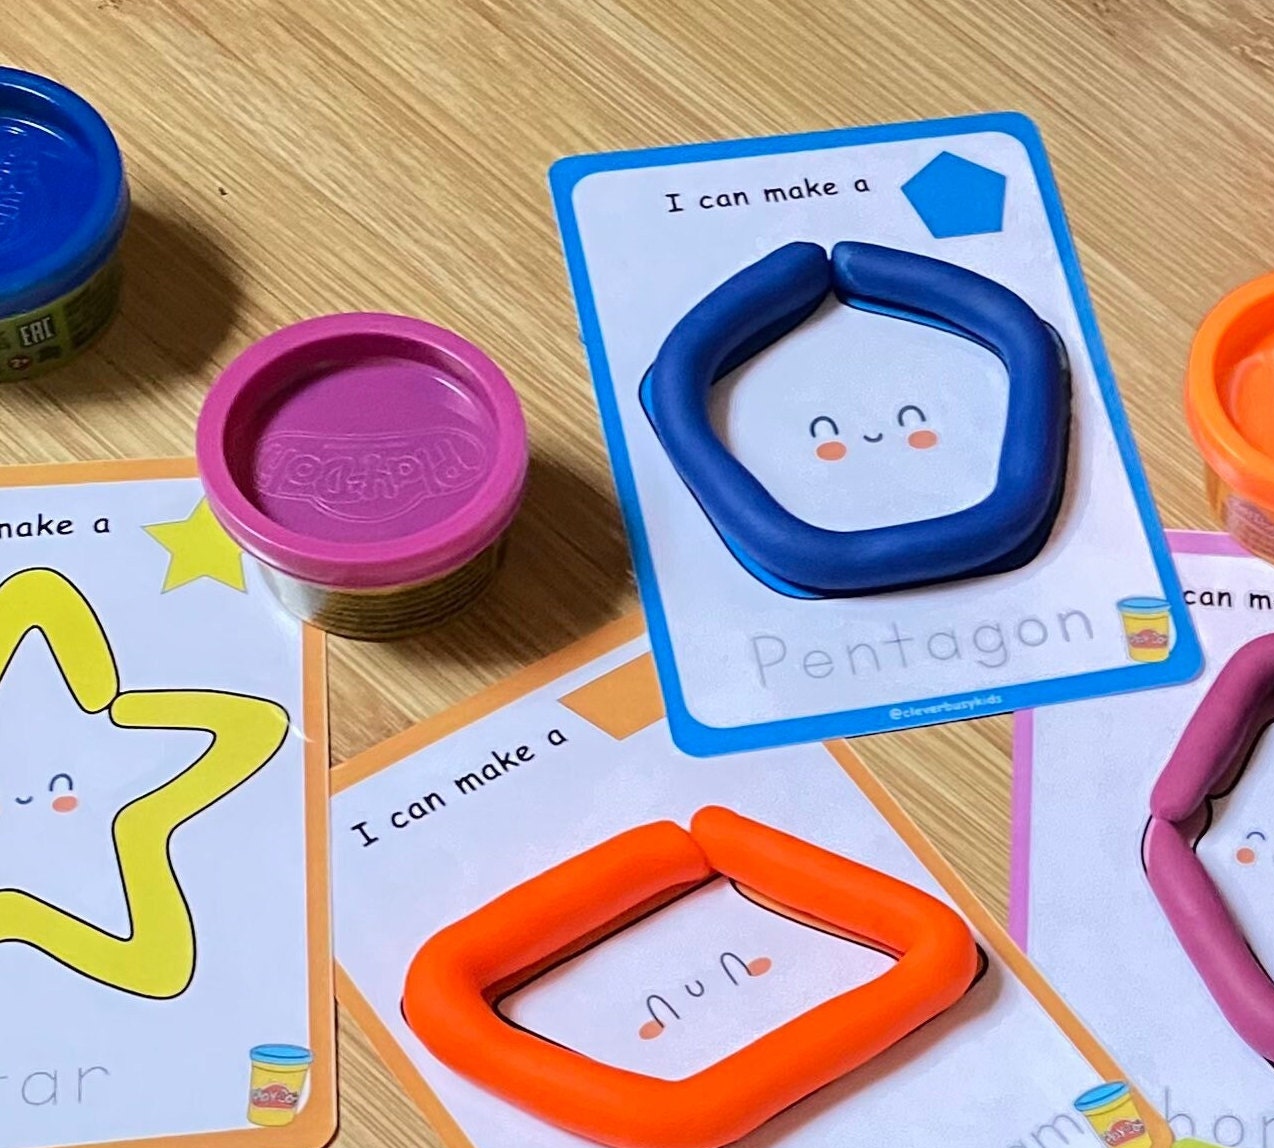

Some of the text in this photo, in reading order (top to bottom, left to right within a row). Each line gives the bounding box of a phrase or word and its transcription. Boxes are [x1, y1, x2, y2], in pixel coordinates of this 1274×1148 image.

[666, 179, 869, 212] I can make a
[94, 518, 109, 533] a
[1183, 590, 1232, 607] can
[750, 608, 1095, 687] Pentagon
[889, 695, 1003, 720] @cleverbusykids
[352, 730, 566, 846] I can make a
